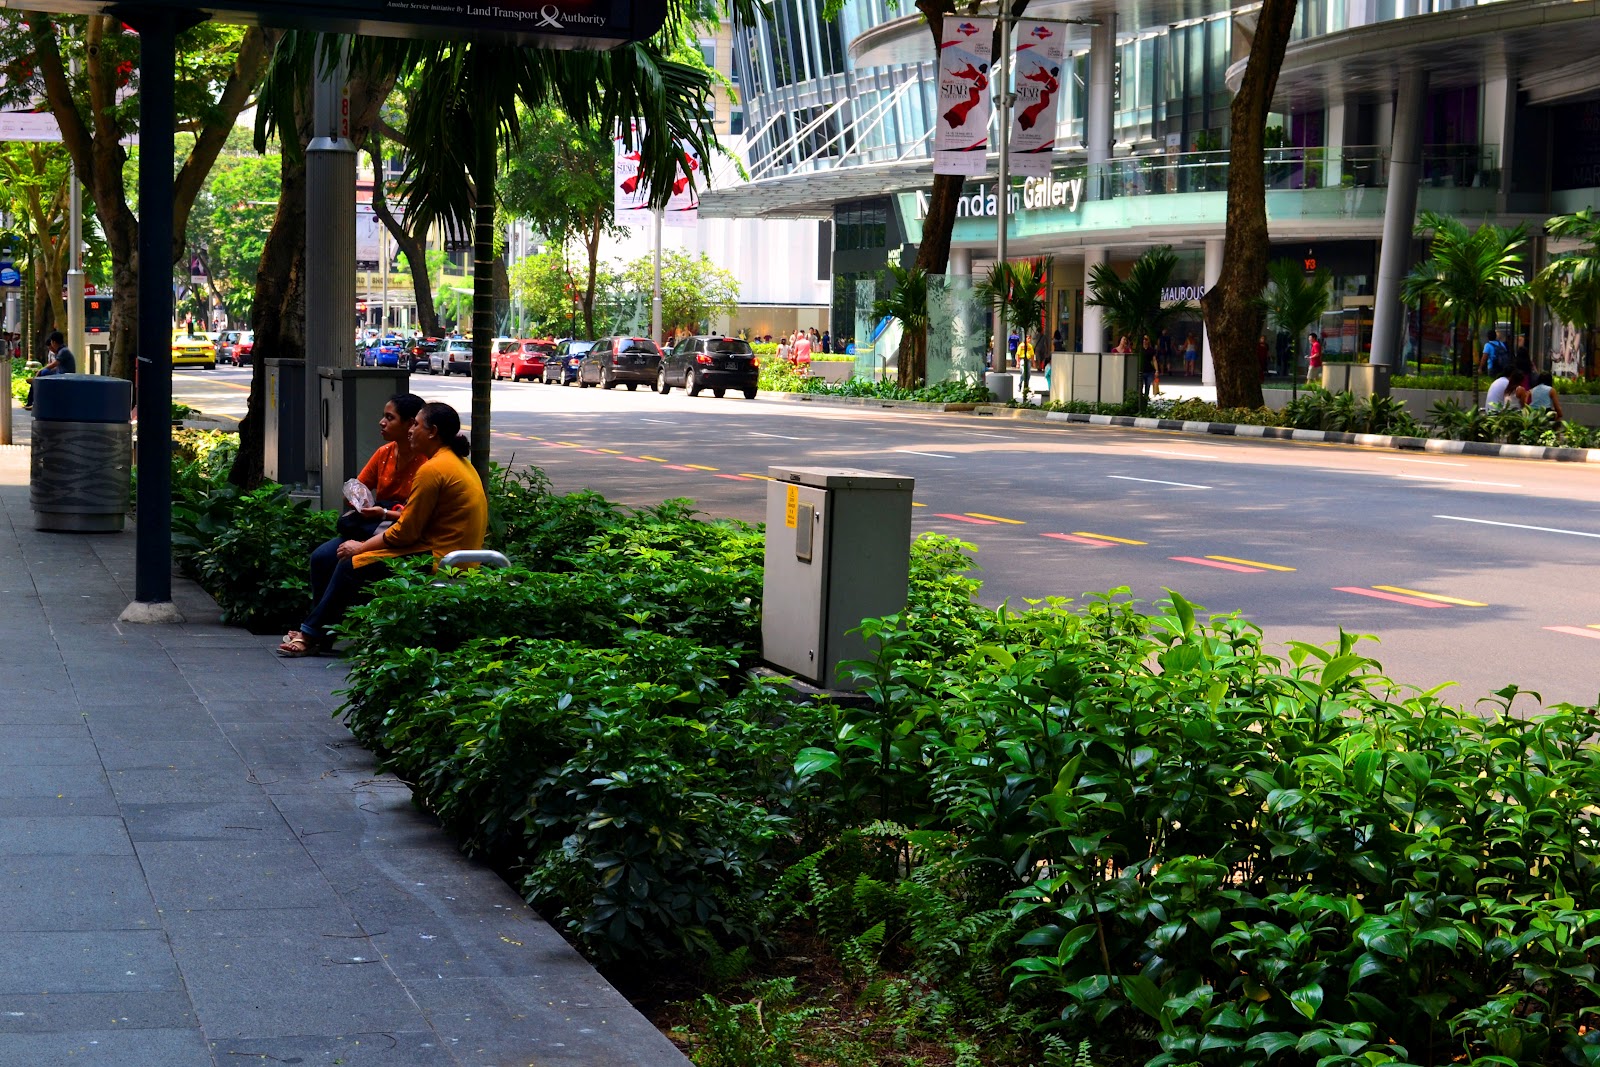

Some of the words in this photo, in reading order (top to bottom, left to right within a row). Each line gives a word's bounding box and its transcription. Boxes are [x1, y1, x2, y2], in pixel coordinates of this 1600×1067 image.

[386, 0, 410, 9] Another
[430, 4, 456, 12] Initiative
[466, 5, 491, 17] Land
[492, 6, 539, 21] Transport
[560, 12, 606, 27] Authority
[941, 84, 968, 95] STAR
[1016, 87, 1039, 98] STAR
[916, 184, 1020, 220] Mndain
[1023, 176, 1083, 213] Gallery
